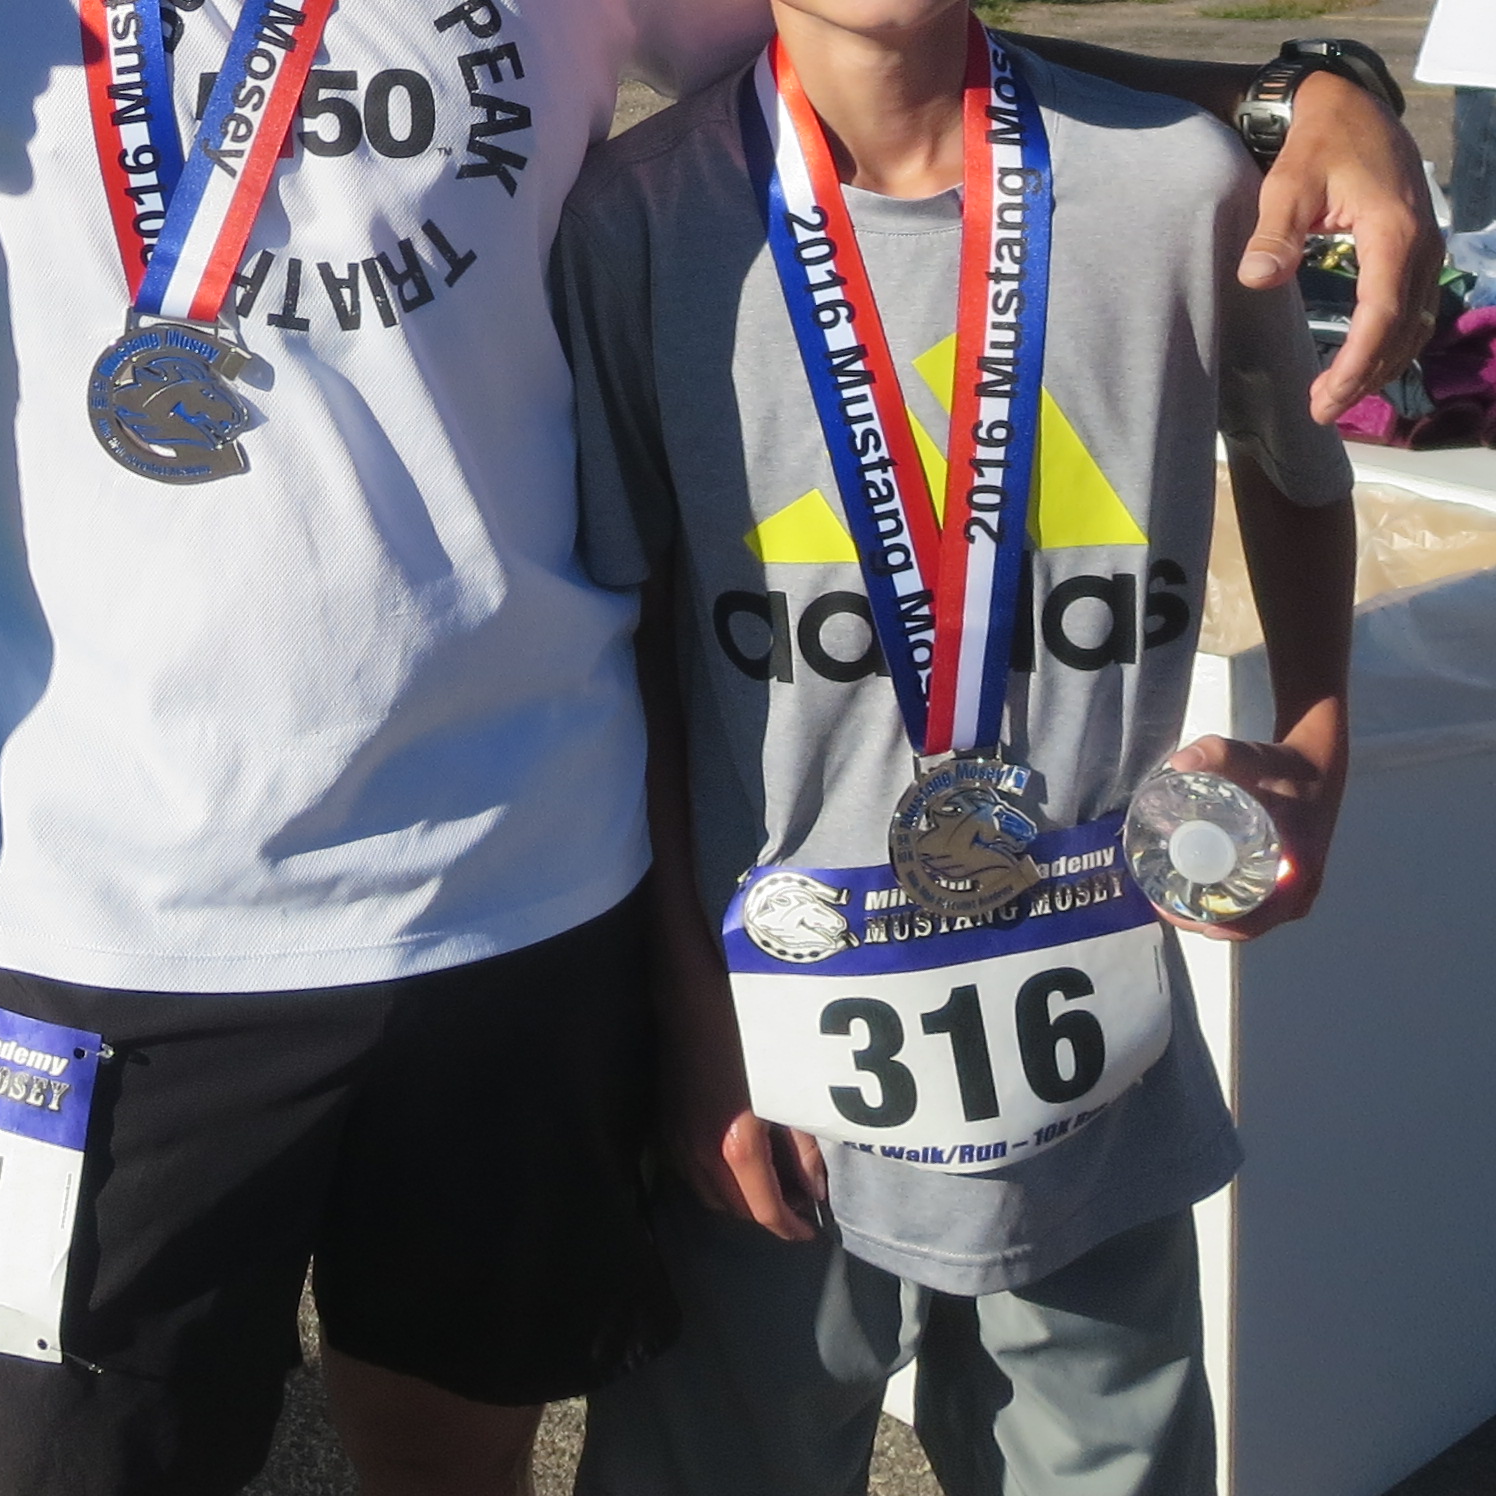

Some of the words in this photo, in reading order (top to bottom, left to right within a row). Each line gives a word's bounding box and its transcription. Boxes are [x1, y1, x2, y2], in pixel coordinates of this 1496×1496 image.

[196, 69, 436, 159] 50
[201, 1, 307, 179] Mosey
[985, 28, 1028, 146] Mos
[232, 219, 478, 332] TRIATH
[975, 166, 1043, 399] Mustang
[784, 206, 854, 332] 2016
[824, 345, 915, 577] Mustang
[895, 589, 937, 705] Mos
[965, 418, 1016, 545] 2016
[712, 551, 1191, 684] adas
[1029, 869, 1126, 918] MOSEY
[1037, 846, 1116, 880] ademy
[818, 966, 1106, 1130] 316
[880, 1140, 1008, 1166] Walk/Run
[1033, 1123, 1071, 1147] 10K
